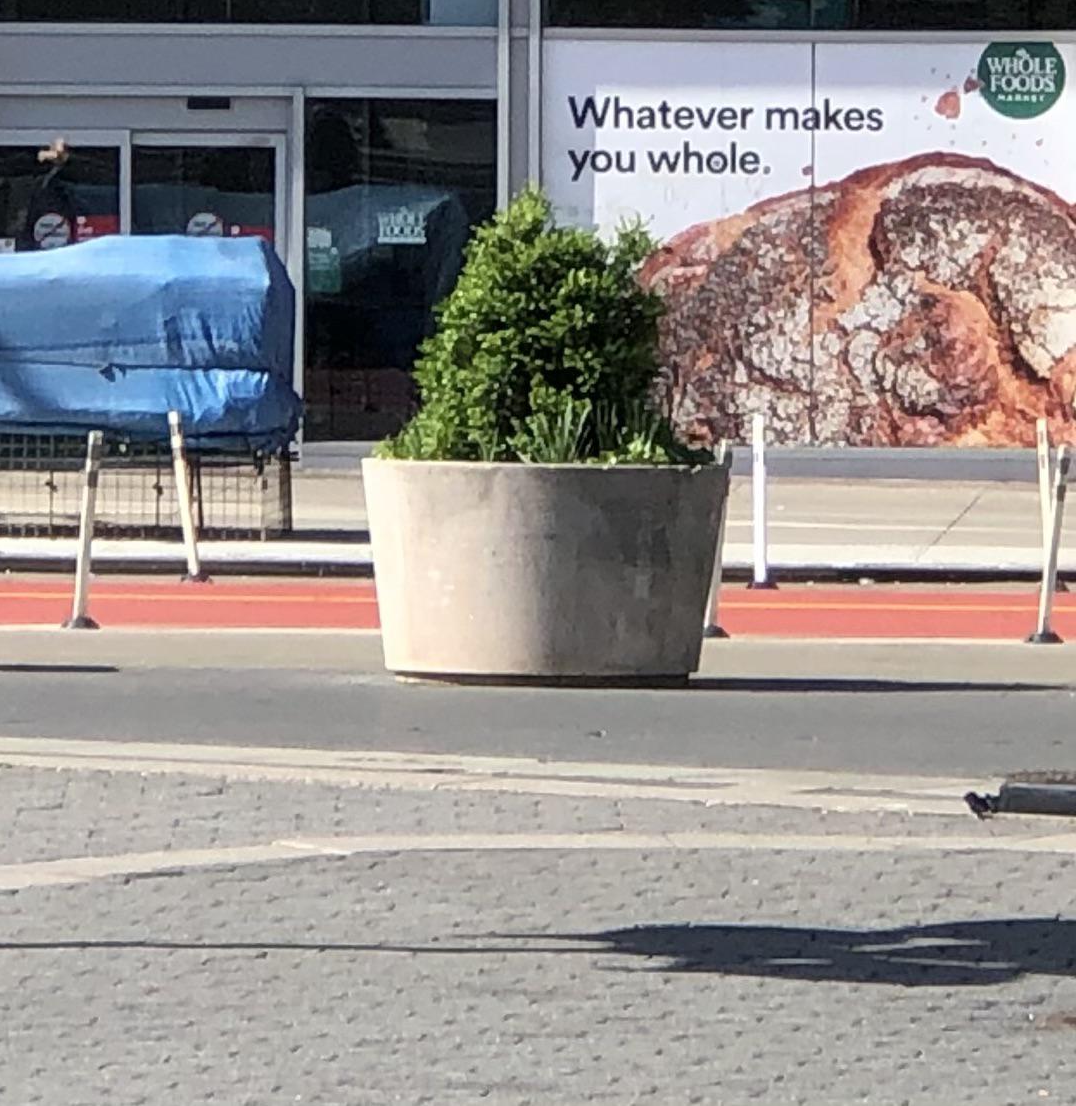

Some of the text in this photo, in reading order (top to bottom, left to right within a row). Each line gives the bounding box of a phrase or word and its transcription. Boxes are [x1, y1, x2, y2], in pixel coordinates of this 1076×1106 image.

[987, 54, 1058, 74] WHOLE
[990, 75, 1056, 92] FOODS
[568, 96, 883, 131] Whatever makes
[568, 141, 771, 181] you whole.
